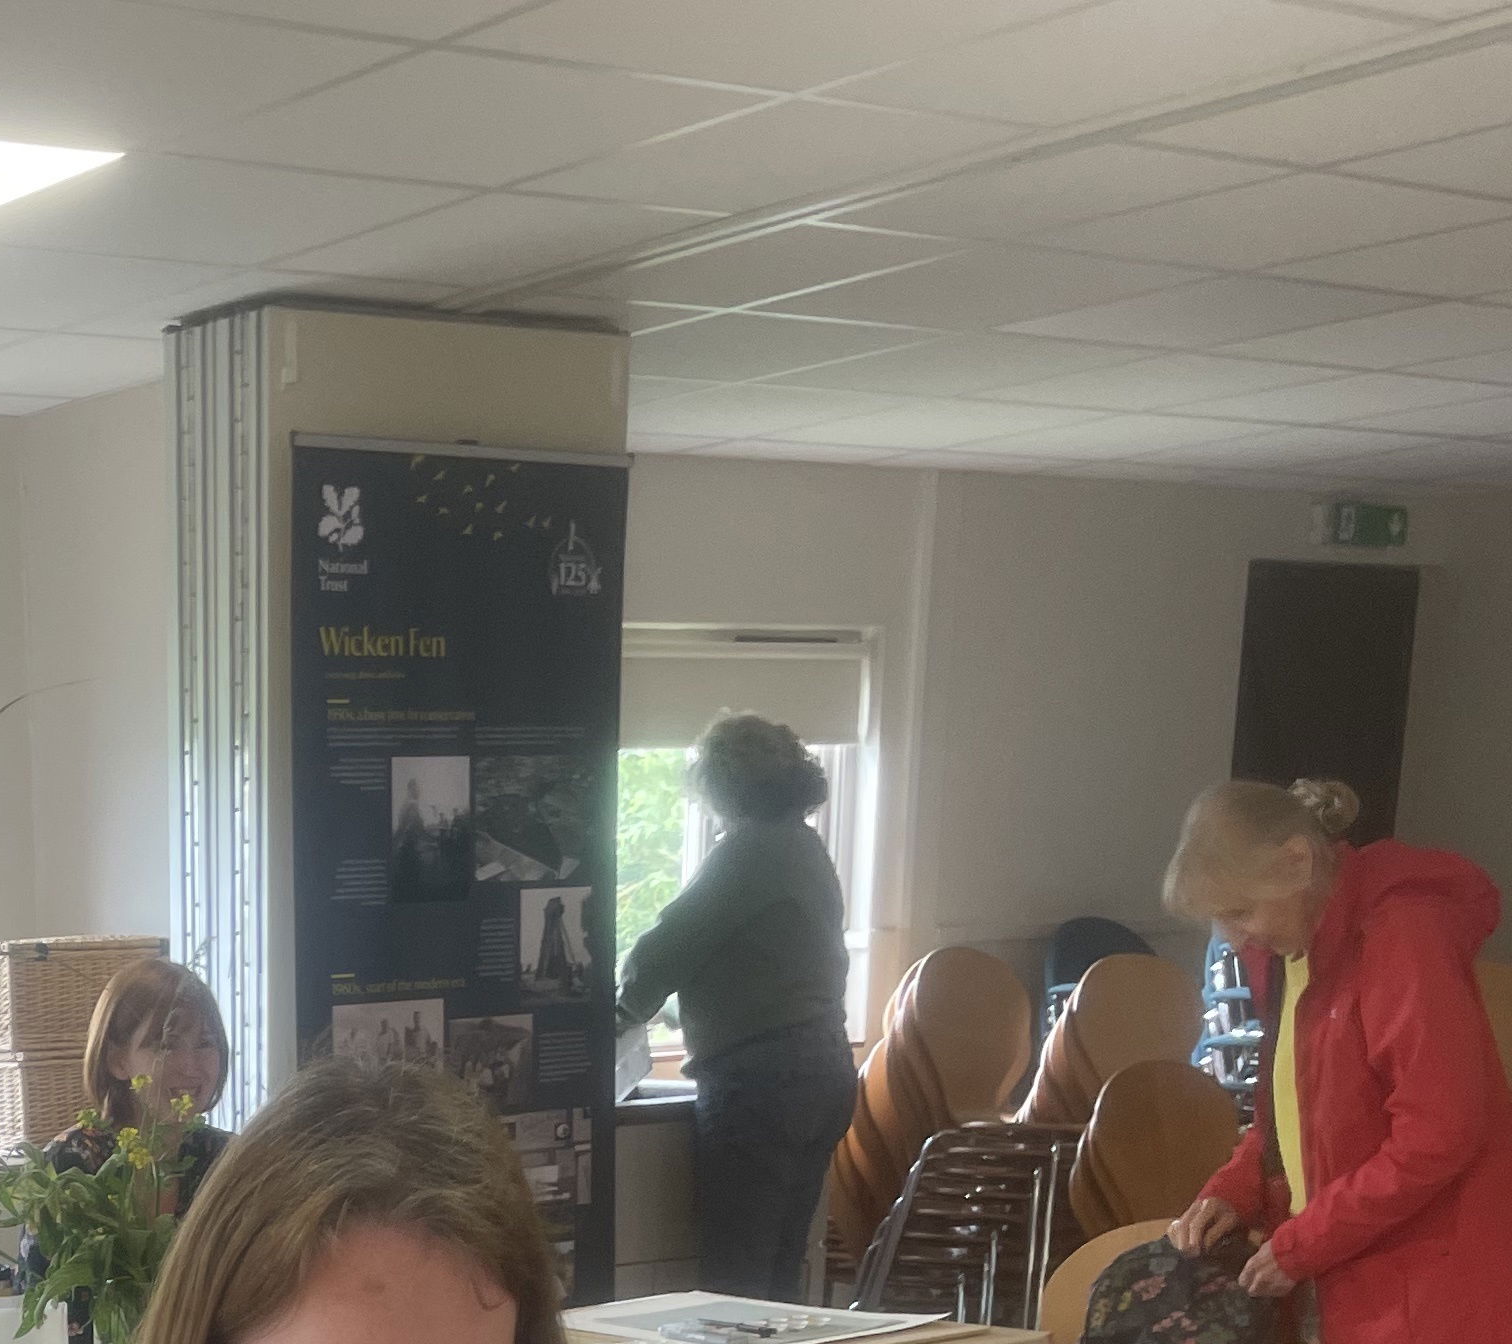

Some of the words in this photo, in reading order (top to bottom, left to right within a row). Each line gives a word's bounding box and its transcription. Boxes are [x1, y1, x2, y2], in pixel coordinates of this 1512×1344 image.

[318, 559, 369, 575] National
[318, 576, 349, 592] Trust
[319, 625, 404, 657] Wicken
[408, 626, 446, 658] Fen
